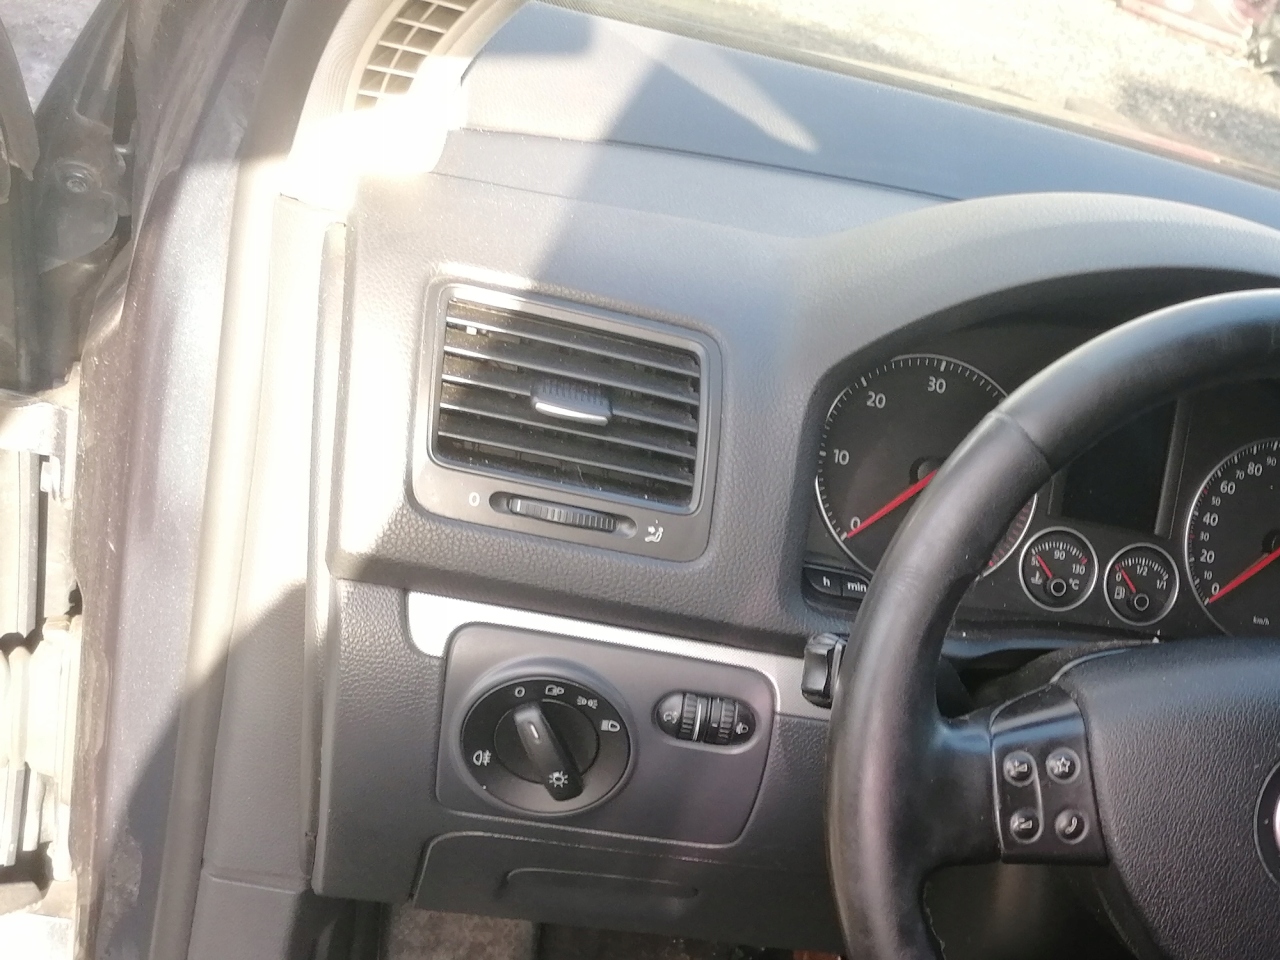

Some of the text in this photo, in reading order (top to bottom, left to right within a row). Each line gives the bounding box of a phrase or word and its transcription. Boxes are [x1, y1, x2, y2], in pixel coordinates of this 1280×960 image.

[927, 376, 946, 394] 30
[866, 391, 886, 409] 20
[833, 449, 850, 465] 10
[1266, 457, 1277, 467] 90
[1235, 470, 1245, 480] 70
[1247, 463, 1263, 476] 80
[1220, 481, 1236, 494] 60
[1211, 497, 1221, 507] 50
[850, 516, 861, 531] 0
[1203, 513, 1219, 527] 40
[1200, 532, 1210, 541] 30
[1054, 551, 1066, 561] 90
[1200, 550, 1215, 563] 20
[1072, 563, 1086, 575] 130
[1136, 566, 1148, 577] 1/2
[1115, 573, 1122, 582] 0
[1203, 570, 1213, 581] 10
[822, 576, 831, 587] h
[847, 580, 867, 594] min
[1156, 579, 1167, 590] 1/1
[1211, 582, 1220, 595] 0
[1253, 615, 1270, 626] km/h
